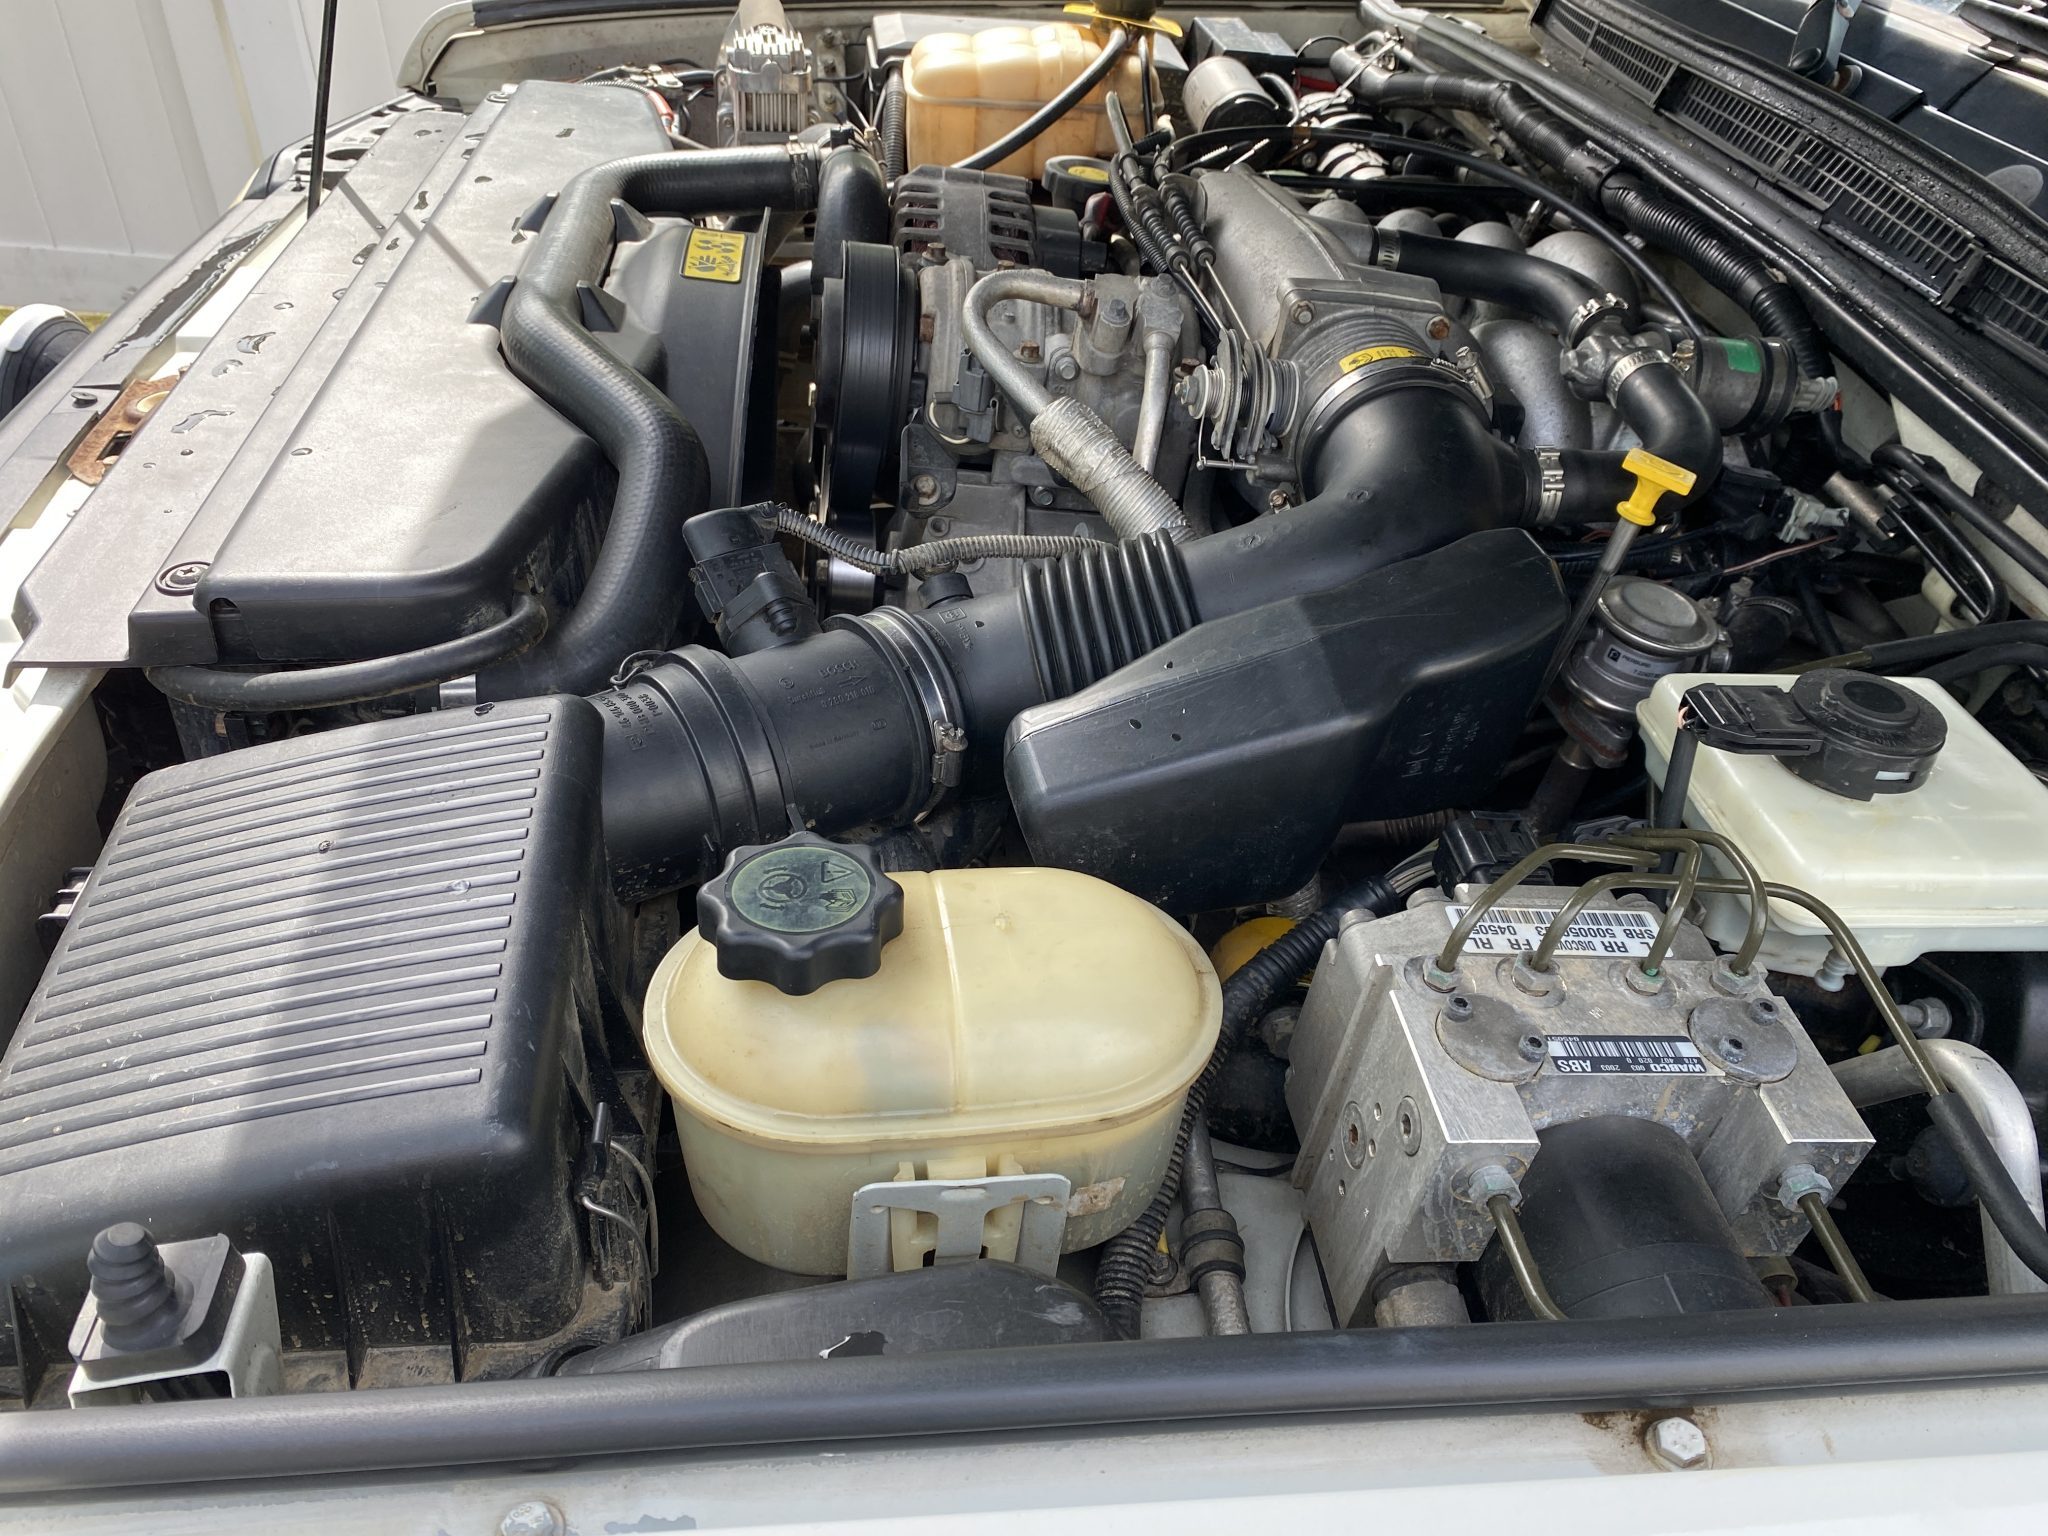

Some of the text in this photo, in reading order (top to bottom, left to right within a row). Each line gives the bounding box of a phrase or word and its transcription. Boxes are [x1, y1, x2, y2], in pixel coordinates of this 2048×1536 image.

[818, 660, 860, 679] BOSCH
[1471, 925, 1517, 936] 04505
[1623, 928, 1656, 939] SRB
[1467, 937, 1494, 950] RL
[1507, 938, 1533, 951] FR
[1545, 939, 1597, 951] DISCOV
[1601, 941, 1629, 953] RR
[1557, 1059, 1592, 1073] ABS
[1649, 1063, 1706, 1072] WABCO
